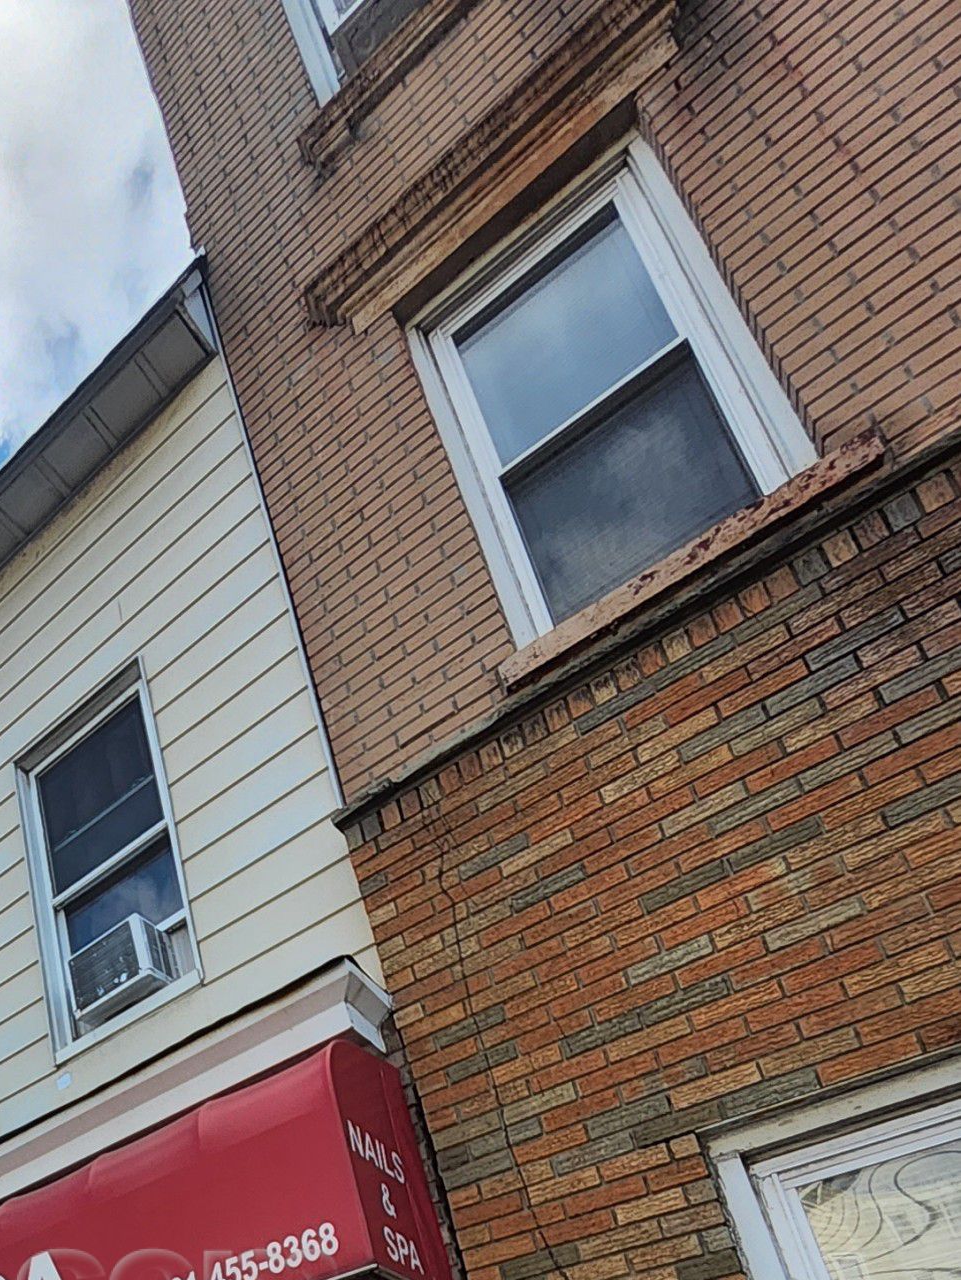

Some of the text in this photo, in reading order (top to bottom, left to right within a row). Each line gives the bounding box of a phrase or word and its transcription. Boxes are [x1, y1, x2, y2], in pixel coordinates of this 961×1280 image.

[347, 1120, 405, 1184] NAILS
[381, 1184, 396, 1219] &
[383, 1226, 425, 1276] SPA
